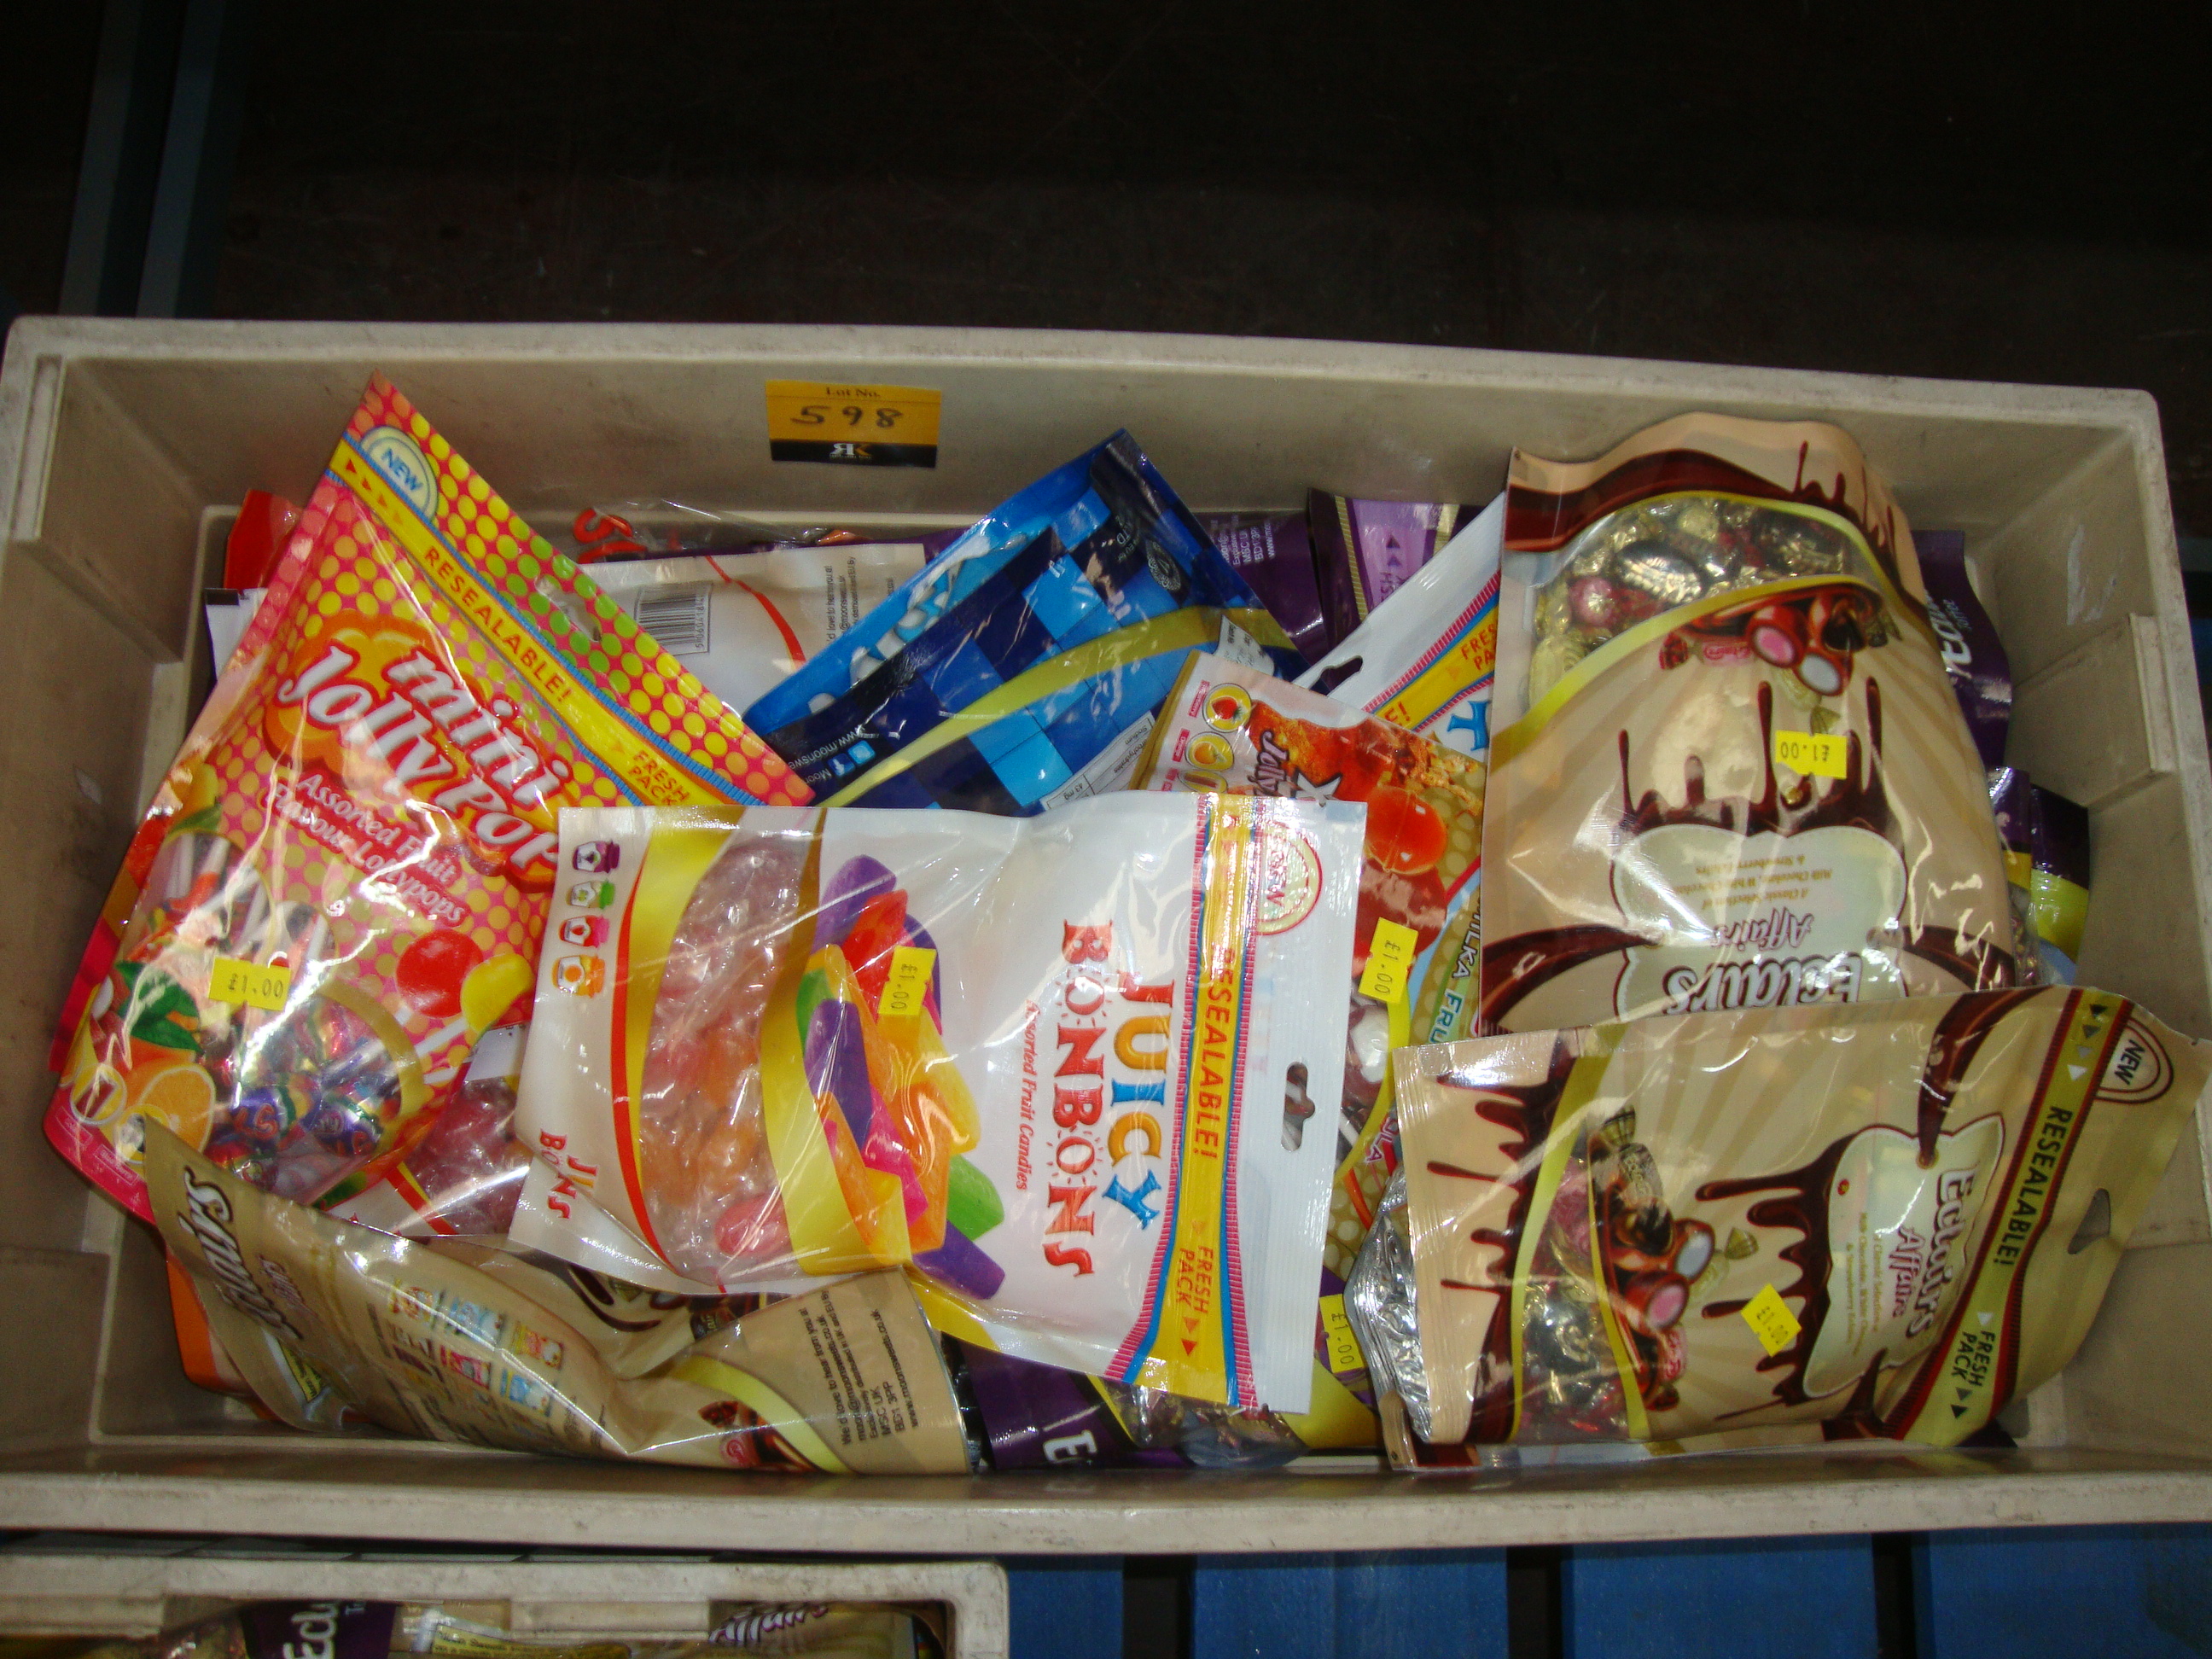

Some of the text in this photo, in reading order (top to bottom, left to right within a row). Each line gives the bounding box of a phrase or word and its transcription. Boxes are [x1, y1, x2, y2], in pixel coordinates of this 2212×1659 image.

[789, 404, 904, 428] 598
[825, 387, 852, 397] Lot
[381, 446, 424, 493] NEW
[424, 544, 573, 702] RESEALABLE!
[277, 646, 455, 797] Jolly
[387, 650, 572, 806] mini
[632, 749, 690, 800] FRESH
[1779, 741, 1831, 763] £1.00
[296, 773, 401, 847] Assorted
[626, 765, 678, 806] PACK
[1710, 905, 1815, 952] Affairs
[226, 972, 286, 999] £1.00
[893, 960, 919, 1013] £1.00
[1374, 939, 1401, 997] £1.00
[1194, 947, 1236, 1159] RESEALABLE!
[2114, 1039, 2146, 1086] NEW
[1021, 1078, 1038, 1121] Fruit
[1042, 919, 1113, 1277] BONBONS
[1102, 969, 1176, 1230] JUICY
[1016, 1123, 1036, 1191] Candies
[1992, 1105, 2074, 1266] RESEALABLE!
[1176, 1248, 1196, 1307] PACK
[1195, 1245, 1215, 1314] FRESH
[1329, 1310, 1356, 1367] £1.00
[1951, 1330, 1978, 1382] PACK
[1968, 1330, 1996, 1388] FRESH
[870, 1385, 893, 1435] MSC UK
[882, 1381, 898, 1405] 3PP
